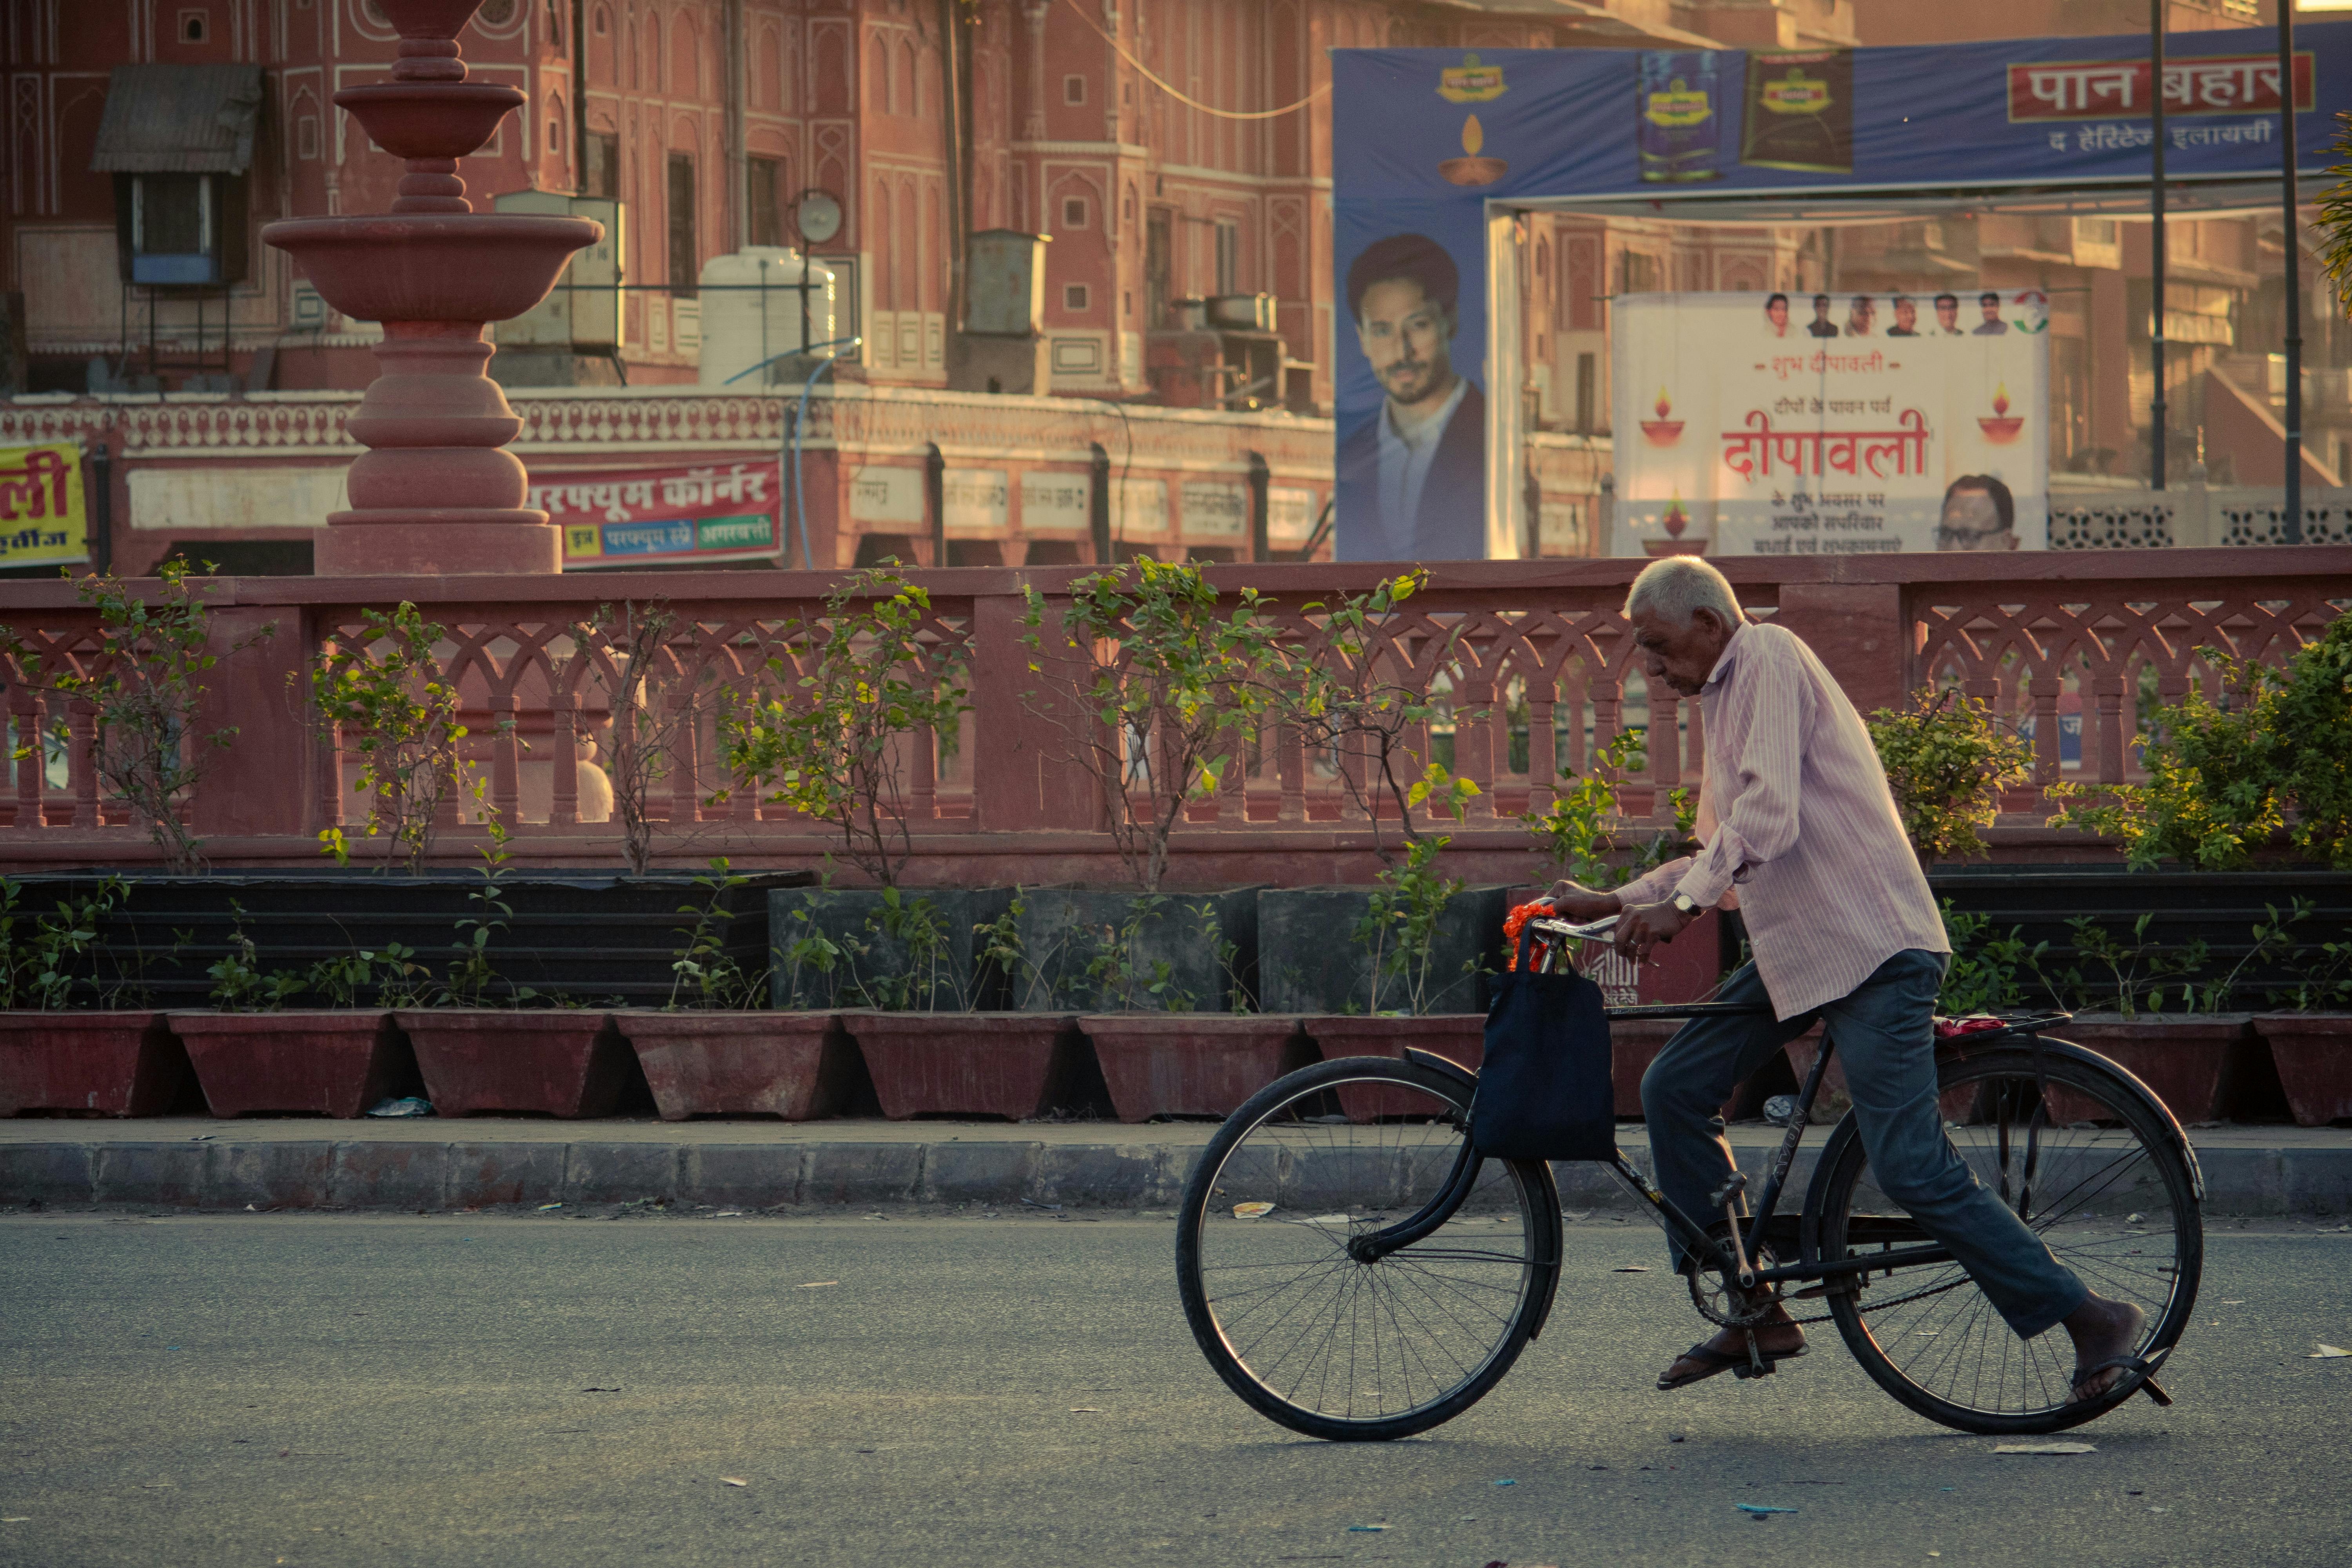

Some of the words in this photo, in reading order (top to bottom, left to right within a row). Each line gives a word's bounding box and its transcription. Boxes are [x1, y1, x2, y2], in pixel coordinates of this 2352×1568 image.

[2028, 65, 2138, 110] पान
[2049, 131, 2065, 152] द
[2172, 119, 2272, 150] इलायची
[1773, 357, 1802, 380] शुभ
[1810, 349, 1884, 373] दीपावली
[1721, 408, 1930, 483] दीपावली
[662, 465, 767, 507] कॉर्नर
[1773, 1105, 1808, 1187] AVON
